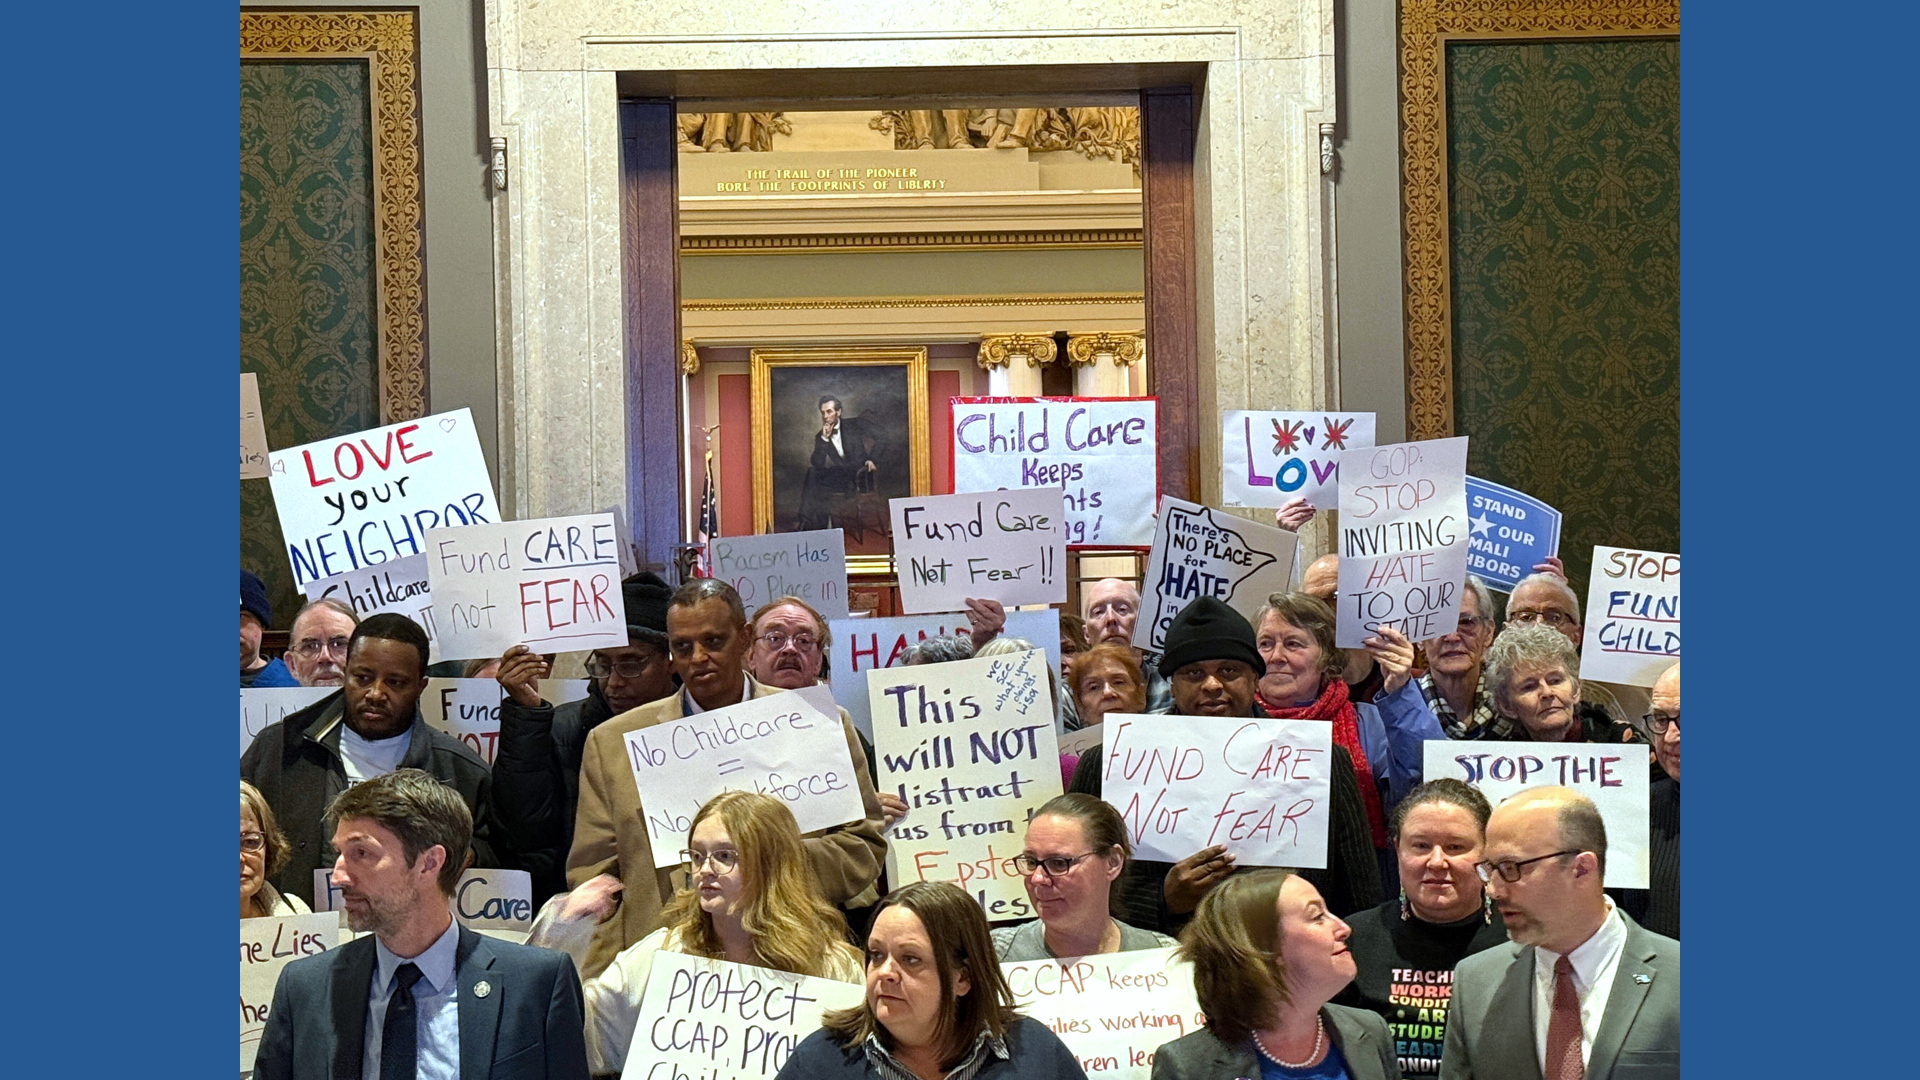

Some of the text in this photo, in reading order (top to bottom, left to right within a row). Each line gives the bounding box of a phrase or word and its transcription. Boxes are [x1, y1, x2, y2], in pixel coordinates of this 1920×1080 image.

[747, 168, 918, 180] THE TRAIL OF THE PIONEER
[759, 182, 781, 191] THE
[790, 181, 866, 191] FOOTPRINTS
[873, 181, 889, 190] OF
[898, 180, 946, 190] LIBERTY
[957, 407, 1146, 453] Child Care
[302, 424, 433, 487] LOVE
[1245, 416, 1339, 492] LOV
[1371, 446, 1424, 479] GOP:
[324, 476, 410, 526] your
[1353, 479, 1436, 519] STOP
[1472, 496, 1527, 521] STAND
[904, 502, 984, 544] Fund
[1173, 513, 1230, 544] There's
[1345, 515, 1456, 558] INVITING
[1497, 525, 1536, 547] OUR
[439, 537, 511, 576] Fund
[523, 524, 615, 564] CARE
[716, 541, 830, 574] Racism Has
[1173, 534, 1253, 567] NO PLACE
[1184, 554, 1208, 568] for
[1603, 551, 1680, 582] STOP
[911, 556, 954, 588] Not
[1165, 562, 1230, 600] HATE
[1364, 553, 1441, 590] HATE
[451, 589, 497, 634] not
[520, 574, 616, 634] FEAR
[1167, 601, 1178, 614] in
[1348, 582, 1456, 620] TO OUR
[1599, 621, 1680, 655] CHILD
[884, 683, 982, 728] This
[444, 731, 499, 766] OT
[631, 712, 814, 772] No Childcare
[883, 735, 954, 774] will
[970, 724, 1051, 766] NOT
[1105, 722, 1205, 786] FUND
[1455, 753, 1623, 788] STOP THE
[650, 809, 691, 840] No
[893, 825, 929, 841] us
[938, 810, 1015, 841] from
[457, 877, 531, 922] Care
[272, 922, 327, 958] Lies
[1007, 962, 1169, 998] CCAP keeps
[1390, 984, 1453, 998] WORK
